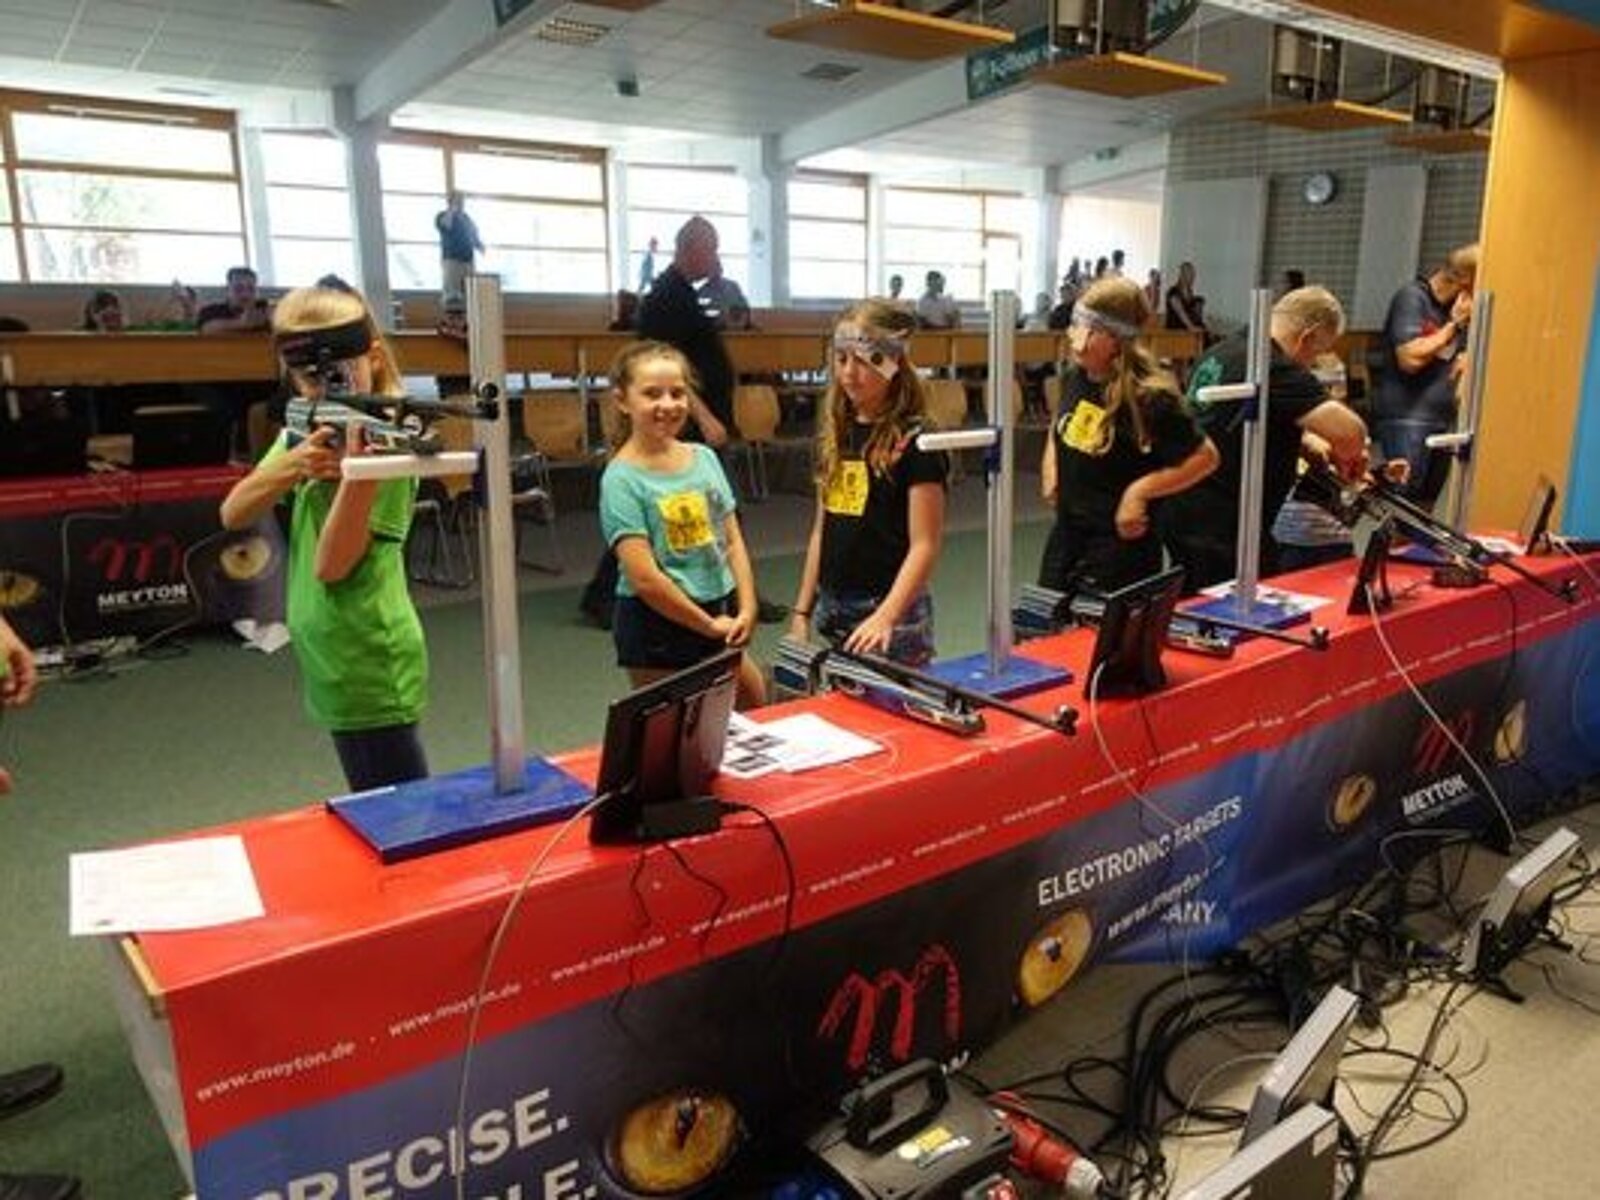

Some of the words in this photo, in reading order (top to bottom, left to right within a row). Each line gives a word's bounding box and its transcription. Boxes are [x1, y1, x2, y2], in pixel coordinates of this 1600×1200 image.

[97, 583, 188, 608] MEYTON
[196, 1041, 356, 1101] www.meyton.de
[250, 1087, 569, 1200] RECISE.
